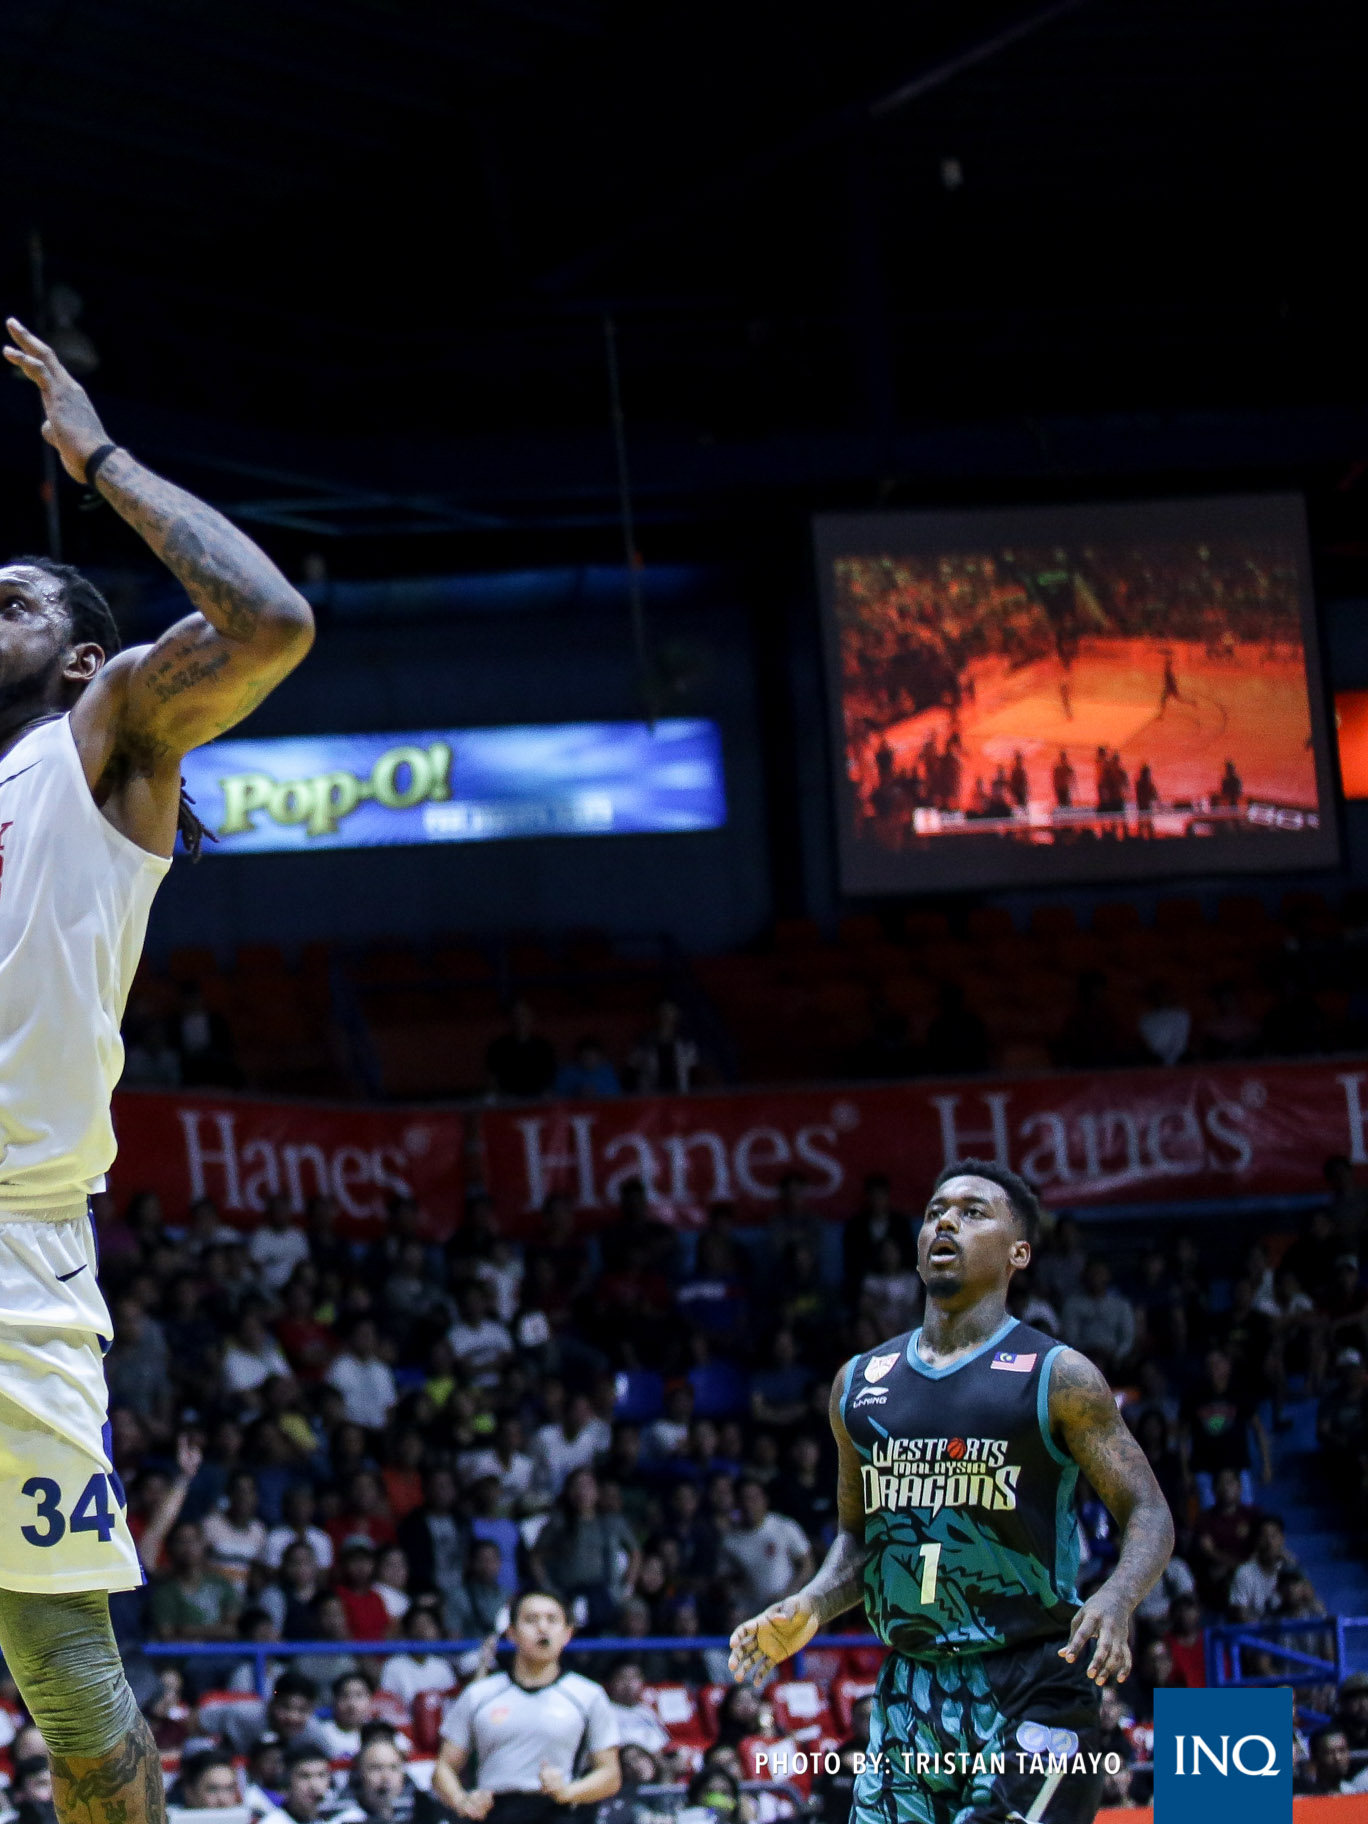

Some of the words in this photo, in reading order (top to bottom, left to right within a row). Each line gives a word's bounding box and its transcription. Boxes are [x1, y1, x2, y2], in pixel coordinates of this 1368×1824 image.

[218, 741, 453, 837] Pop-O!
[178, 1109, 415, 1220] Hanes
[516, 1112, 845, 1213] Hanes
[932, 1089, 1254, 1186] Hanes
[21, 1473, 115, 1547] 34
[860, 1465, 1021, 1518] DRAGONS
[917, 1542, 942, 1605] 1
